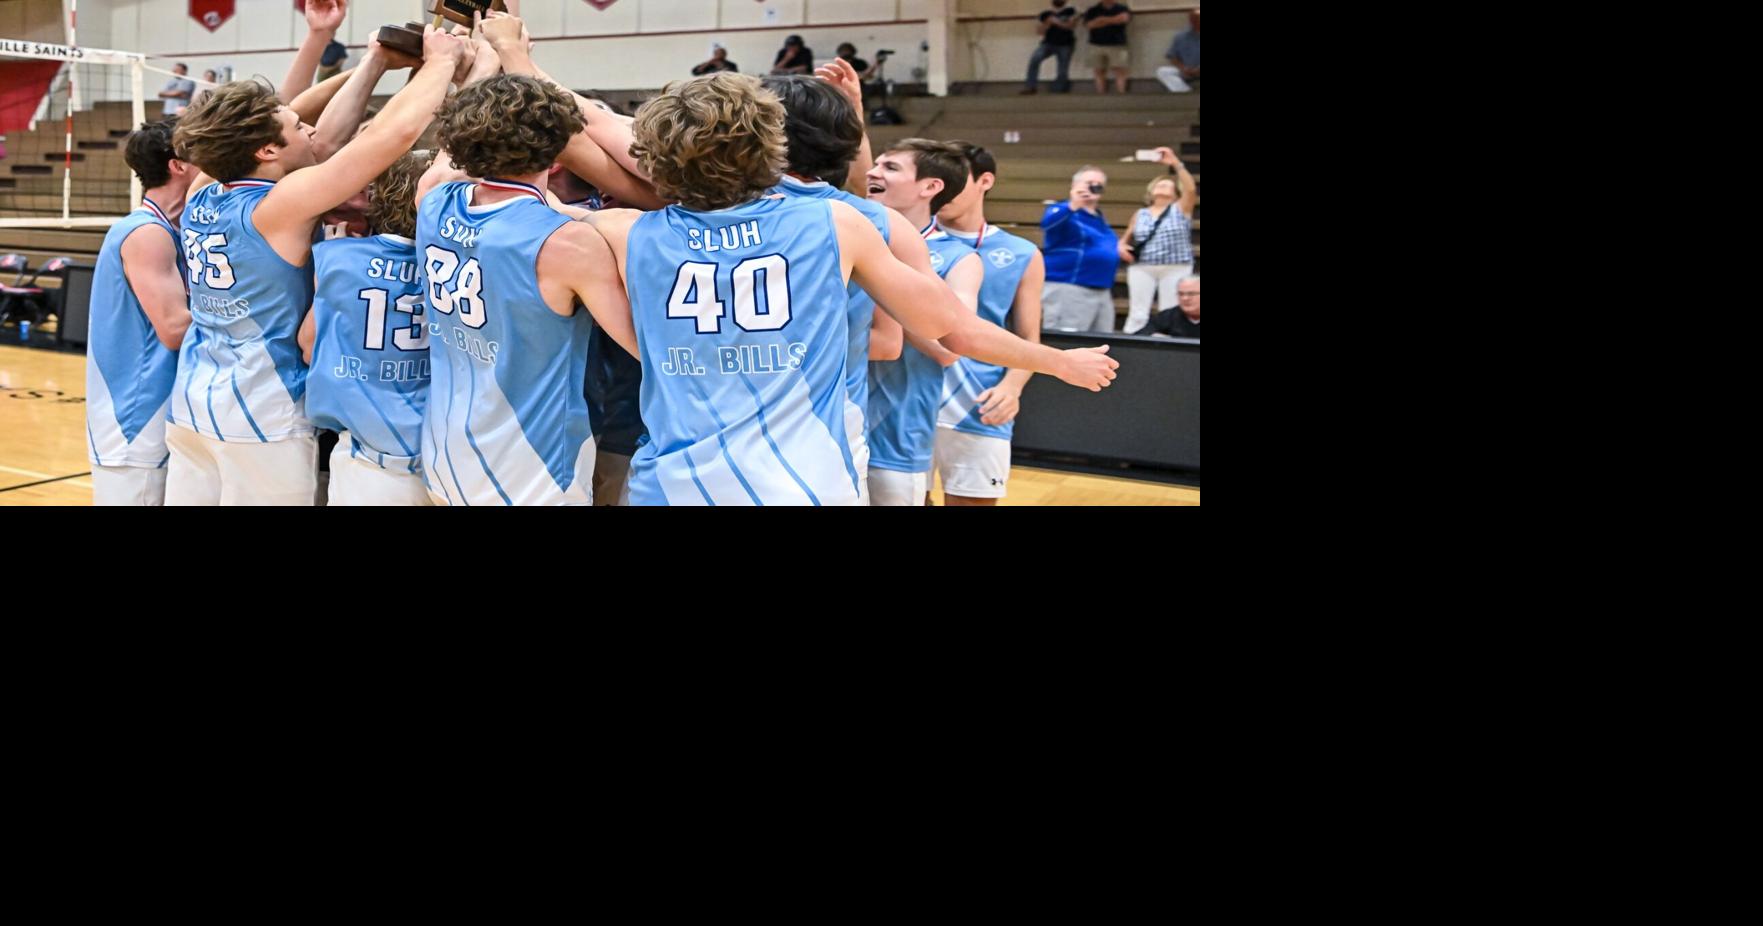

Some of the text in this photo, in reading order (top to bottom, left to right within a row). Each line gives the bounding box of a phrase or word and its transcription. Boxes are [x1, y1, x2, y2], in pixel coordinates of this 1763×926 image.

[184, 227, 237, 290] 45
[688, 219, 762, 252] SLUH
[424, 244, 488, 329] 88
[666, 252, 793, 334] 40
[358, 287, 431, 352] 13
[334, 354, 431, 382] JR. BILL
[661, 342, 807, 375] JR. BILLS
